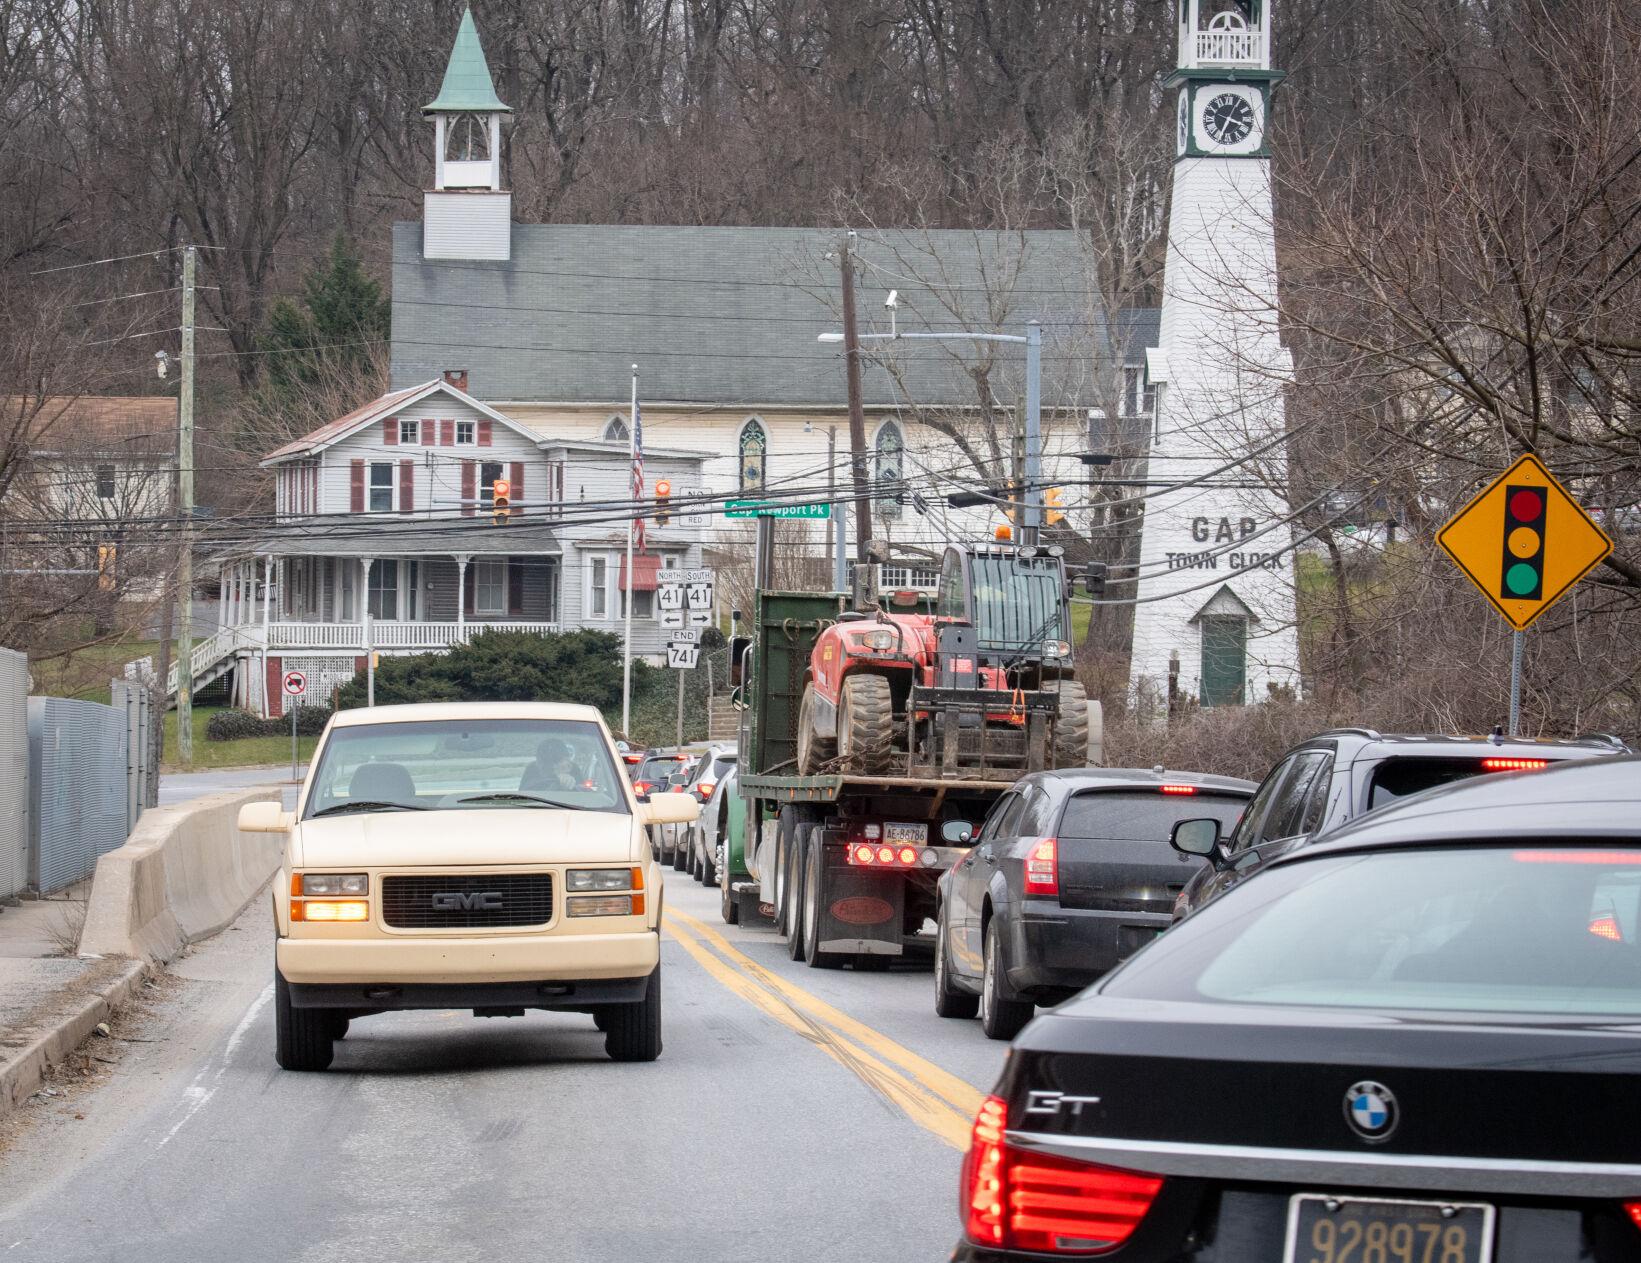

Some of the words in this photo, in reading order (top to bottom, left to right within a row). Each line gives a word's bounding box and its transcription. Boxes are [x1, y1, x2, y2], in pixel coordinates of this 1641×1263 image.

[758, 504, 807, 516] Newport
[810, 505, 824, 514] Pk
[688, 516, 703, 524] RED
[1191, 516, 1257, 543] GAP
[1165, 552, 1217, 570] TOWN
[1229, 552, 1285, 570] CLOCK
[658, 571, 681, 580] NORTH
[687, 571, 710, 581] SOUTH
[662, 589, 679, 603] 41
[690, 589, 707, 603] 41
[674, 631, 694, 640] END
[672, 648, 694, 664] 741
[432, 891, 503, 911] GMC
[1024, 1091, 1102, 1115] GT
[1310, 1218, 1468, 1263] 928978
